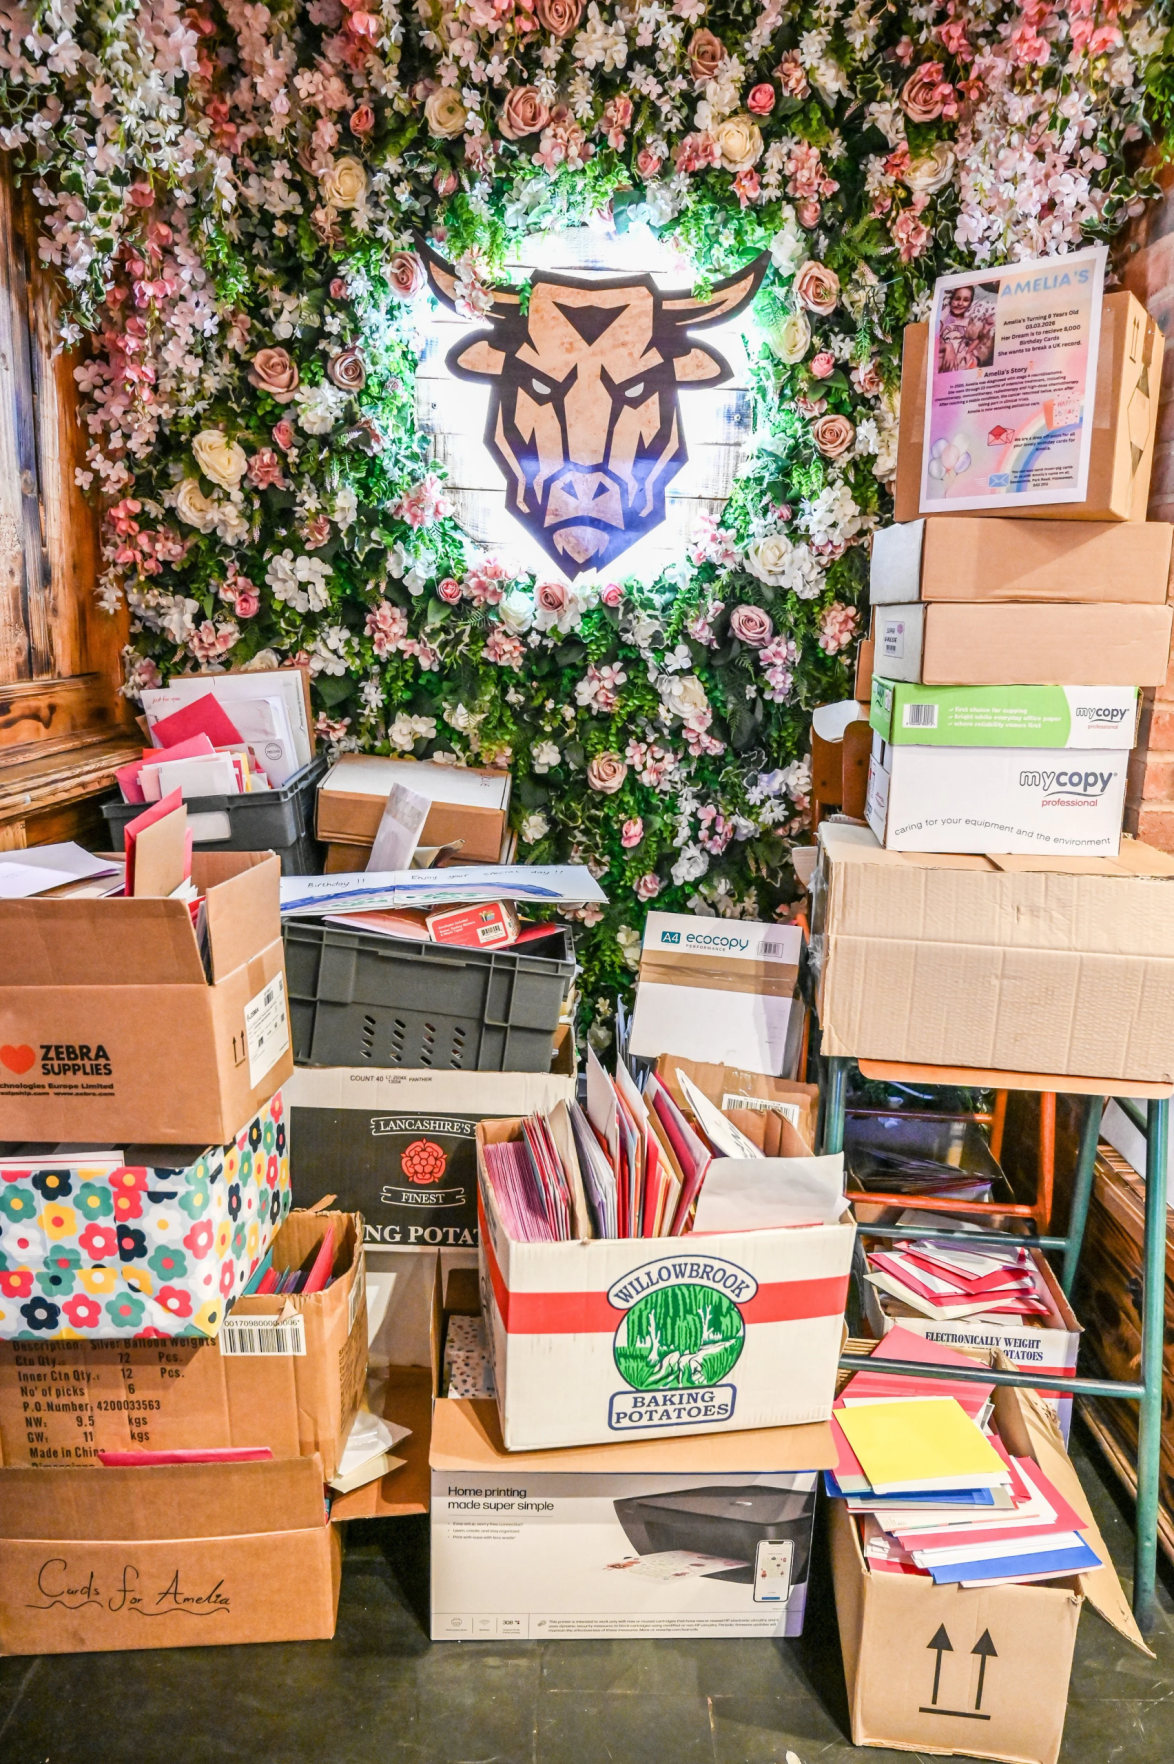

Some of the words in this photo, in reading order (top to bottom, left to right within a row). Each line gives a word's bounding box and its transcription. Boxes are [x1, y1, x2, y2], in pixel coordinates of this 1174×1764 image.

[1001, 270, 1089, 297] AMELIA'S
[1027, 314, 1046, 322] Turning
[1025, 321, 1055, 330] 03.03.2026
[1020, 337, 1042, 345] Birthday
[984, 369, 1009, 378] Amelia's
[1041, 798, 1098, 808] professional
[895, 822, 923, 836] caring
[925, 818, 938, 826] for
[941, 817, 962, 825] your
[965, 818, 1014, 833] equipment
[1016, 827, 1034, 838] and
[1036, 833, 1050, 841] the
[1053, 836, 1111, 846] environment
[662, 932, 679, 943] A4
[686, 934, 749, 951] ecocopy
[40, 1044, 110, 1061] ZEBRA
[42, 1063, 112, 1075] SUPPLIES
[380, 1119, 471, 1134] LANCASHIRE'S
[401, 1192, 445, 1204] FINEST
[613, 1262, 750, 1304] WILLOWBROOK
[90, 1339, 121, 1350] Silver
[124, 1339, 166, 1349] Balloon
[170, 1337, 216, 1348] Weights
[926, 1332, 1002, 1346] ELECTRONICALLY
[1004, 1337, 1041, 1349] WEIGHT
[16, 1355, 34, 1366] Ctn
[119, 1353, 130, 1363] 72
[158, 1352, 183, 1362] Pcs.
[1004, 1350, 1043, 1361] OTATOES
[18, 1371, 47, 1382] Inner
[51, 1370, 70, 1381] Ctn
[122, 1368, 133, 1379] 12
[160, 1367, 184, 1378] Pcs.
[42, 1386, 52, 1397] of
[55, 1385, 85, 1399] picks
[128, 1384, 135, 1394] 6
[97, 1400, 160, 1410] 4200033563
[632, 1391, 715, 1408] BAKING
[614, 1404, 729, 1424] POTATOES
[25, 1417, 47, 1428] NW:
[76, 1416, 94, 1427] 9.5
[128, 1415, 148, 1427] kgs
[27, 1432, 48, 1443] GW:
[83, 1431, 93, 1442] 11
[130, 1430, 150, 1443] kgs
[29, 1447, 58, 1458] Made
[61, 1447, 72, 1457] in
[448, 1486, 482, 1496] Home
[485, 1487, 526, 1499] printing
[448, 1500, 480, 1509] made
[483, 1502, 515, 1511] super
[517, 1501, 554, 1512] simple
[38, 1558, 100, 1599] Cards
[108, 1565, 144, 1611] for
[156, 1569, 231, 1606] Amelia
